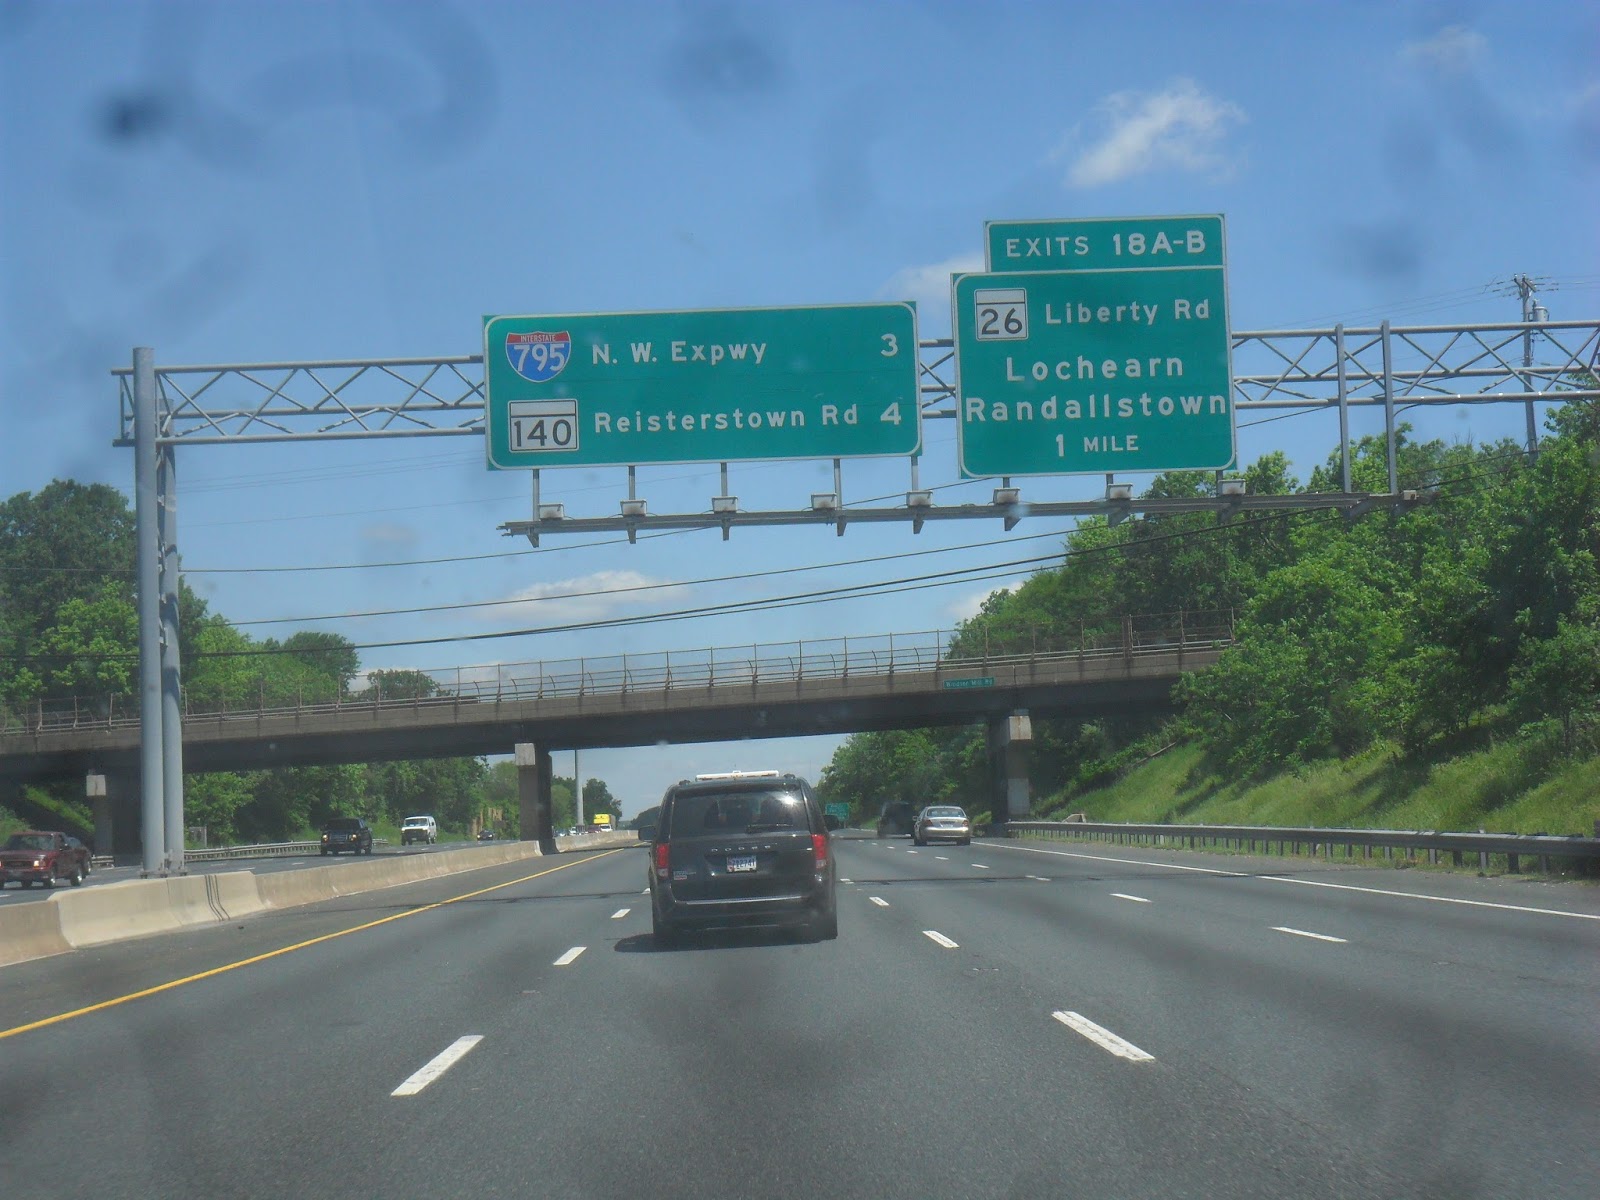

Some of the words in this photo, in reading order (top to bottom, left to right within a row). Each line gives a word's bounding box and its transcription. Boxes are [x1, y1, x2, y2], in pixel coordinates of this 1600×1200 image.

[1006, 236, 1089, 258] EXITS
[1113, 230, 1206, 256] 18A-B
[980, 307, 1023, 335] 26
[1045, 301, 1158, 325] Liberty
[1174, 298, 1210, 320] Rd
[520, 334, 556, 343] INTERSTATE
[592, 343, 618, 365] N.
[631, 341, 658, 363] W.
[671, 340, 767, 365] Expwy
[880, 333, 899, 357] 3
[514, 343, 565, 371] 795
[1006, 355, 1183, 382] Lochearn
[595, 408, 806, 433] Reisterstown
[822, 403, 859, 426] Rd
[879, 402, 902, 425] 4
[966, 392, 1226, 422] Randallstown
[513, 418, 573, 448] 140
[1055, 434, 1065, 457] 1
[1083, 434, 1139, 452] MILE
